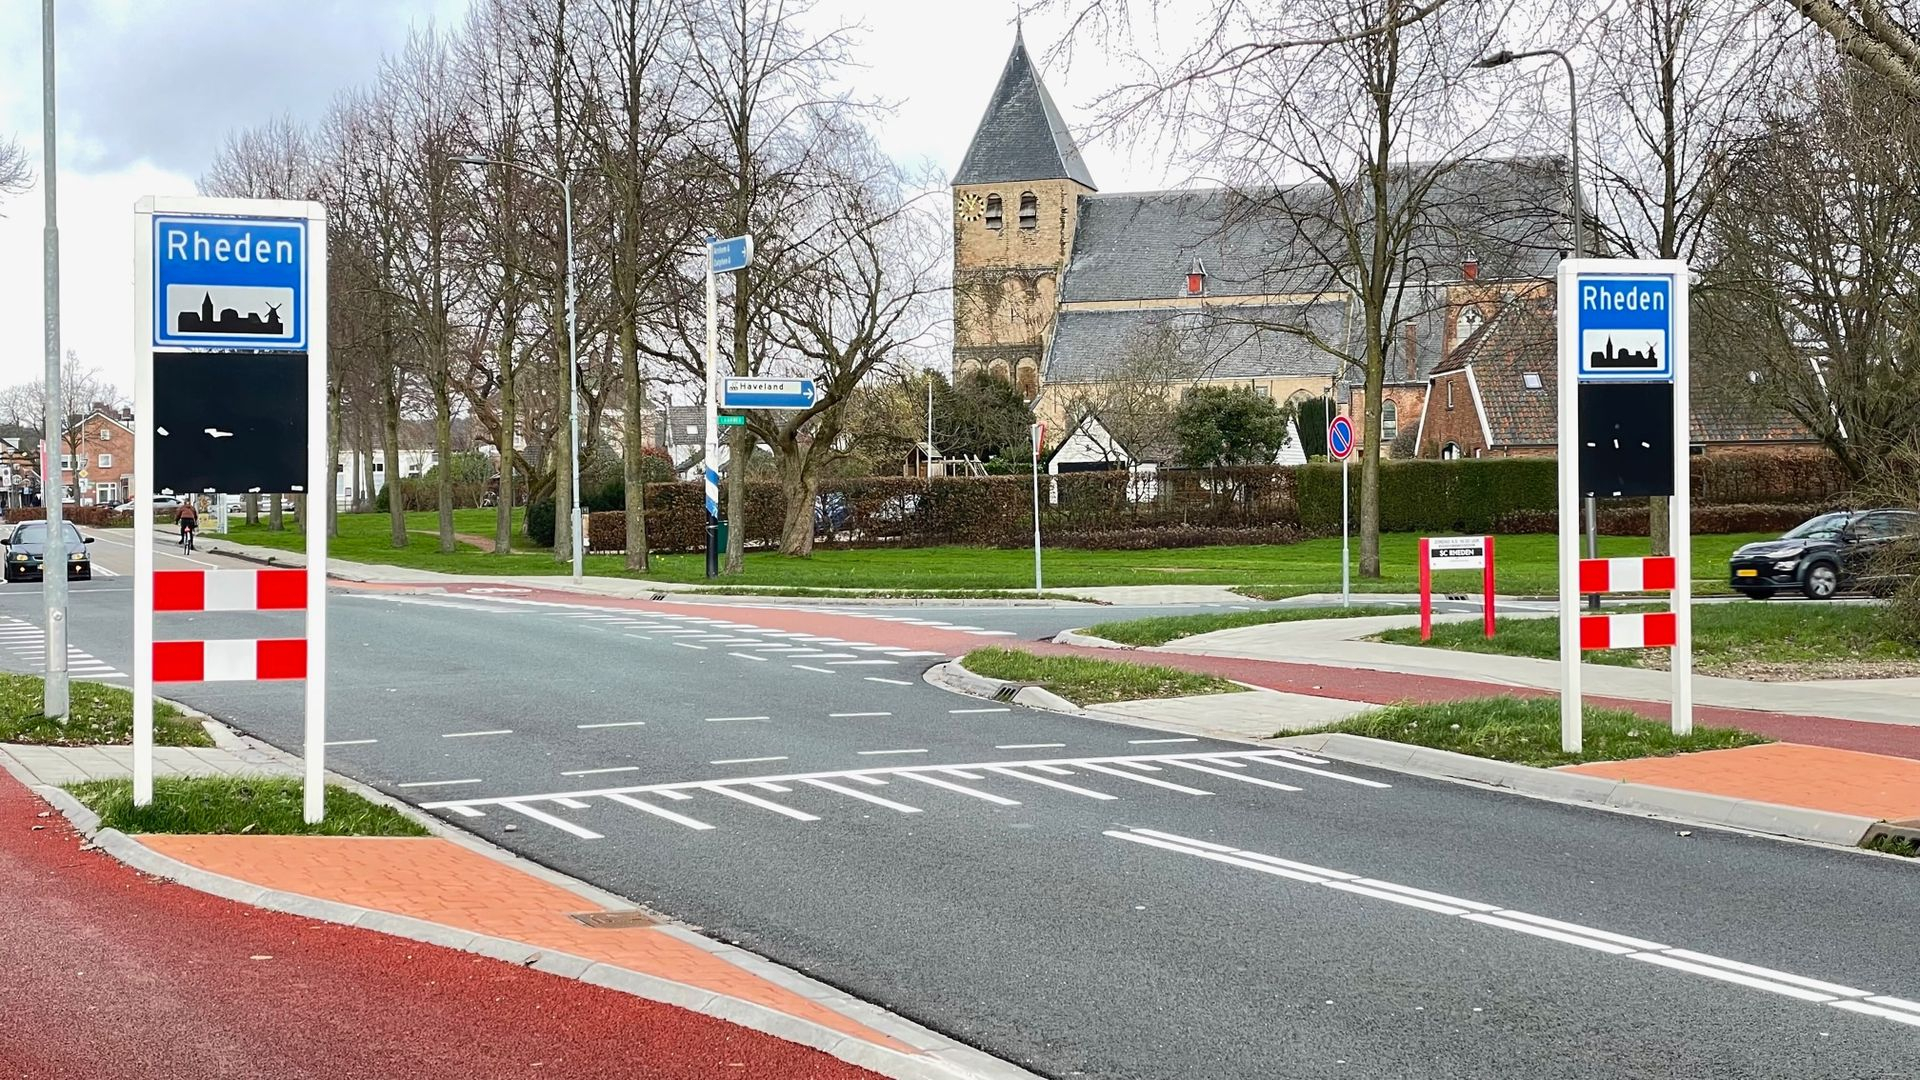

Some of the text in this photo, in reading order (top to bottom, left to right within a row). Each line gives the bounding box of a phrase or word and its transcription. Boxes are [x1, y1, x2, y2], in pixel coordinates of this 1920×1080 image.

[168, 229, 293, 264] Rheden
[1583, 285, 1665, 311] Rheden
[739, 383, 784, 391] Haveland
[1439, 549, 1448, 557] SC
